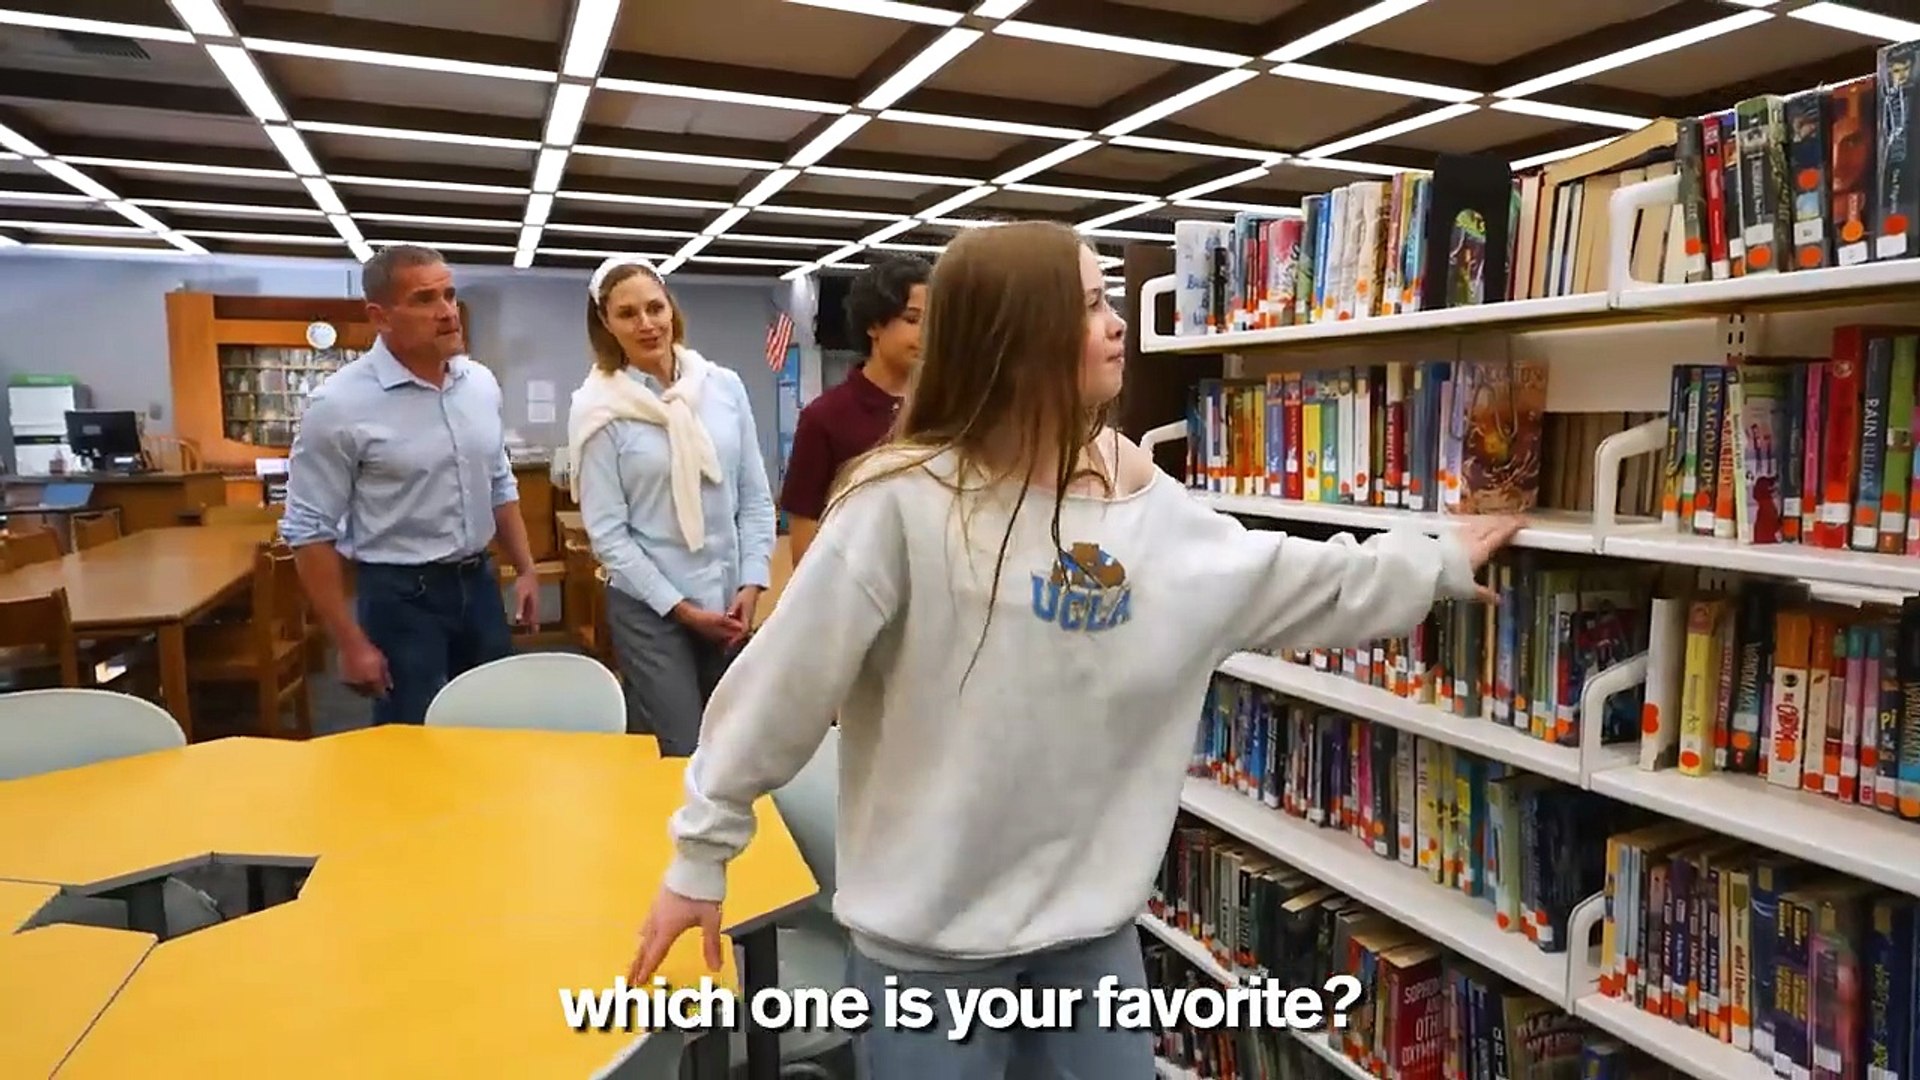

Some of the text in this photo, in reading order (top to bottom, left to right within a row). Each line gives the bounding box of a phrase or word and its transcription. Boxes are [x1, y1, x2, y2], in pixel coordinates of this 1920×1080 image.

[1703, 381, 1720, 456] DRAGON
[1863, 398, 1881, 438] RAIN
[1031, 575, 1131, 631] UCLA
